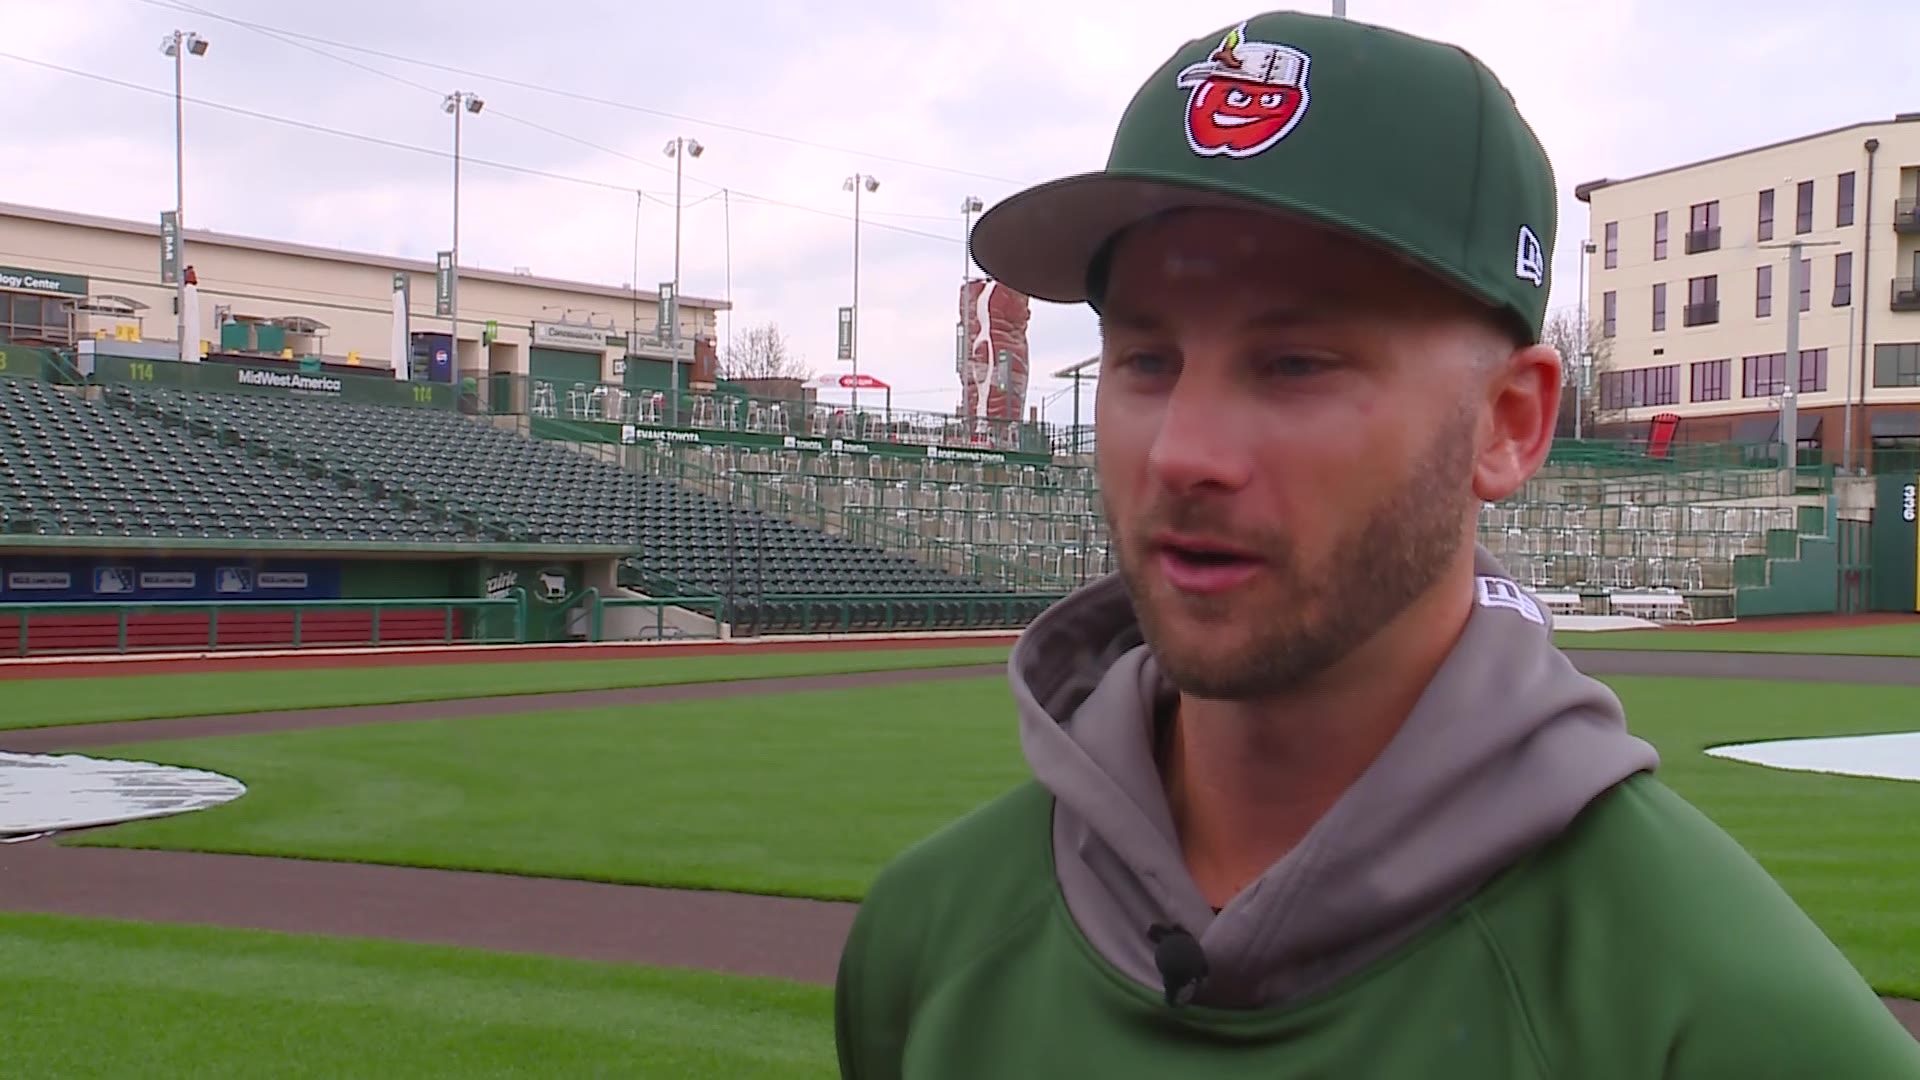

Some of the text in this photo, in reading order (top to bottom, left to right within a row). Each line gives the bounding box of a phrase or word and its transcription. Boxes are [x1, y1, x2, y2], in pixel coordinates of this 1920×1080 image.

[165, 236, 174, 260] BAR
[24, 275, 61, 290] Center
[129, 362, 154, 382] 114
[413, 385, 432, 402] 114
[636, 429, 700, 442] EVANS TOYOTA
[1903, 484, 1916, 521] 336
